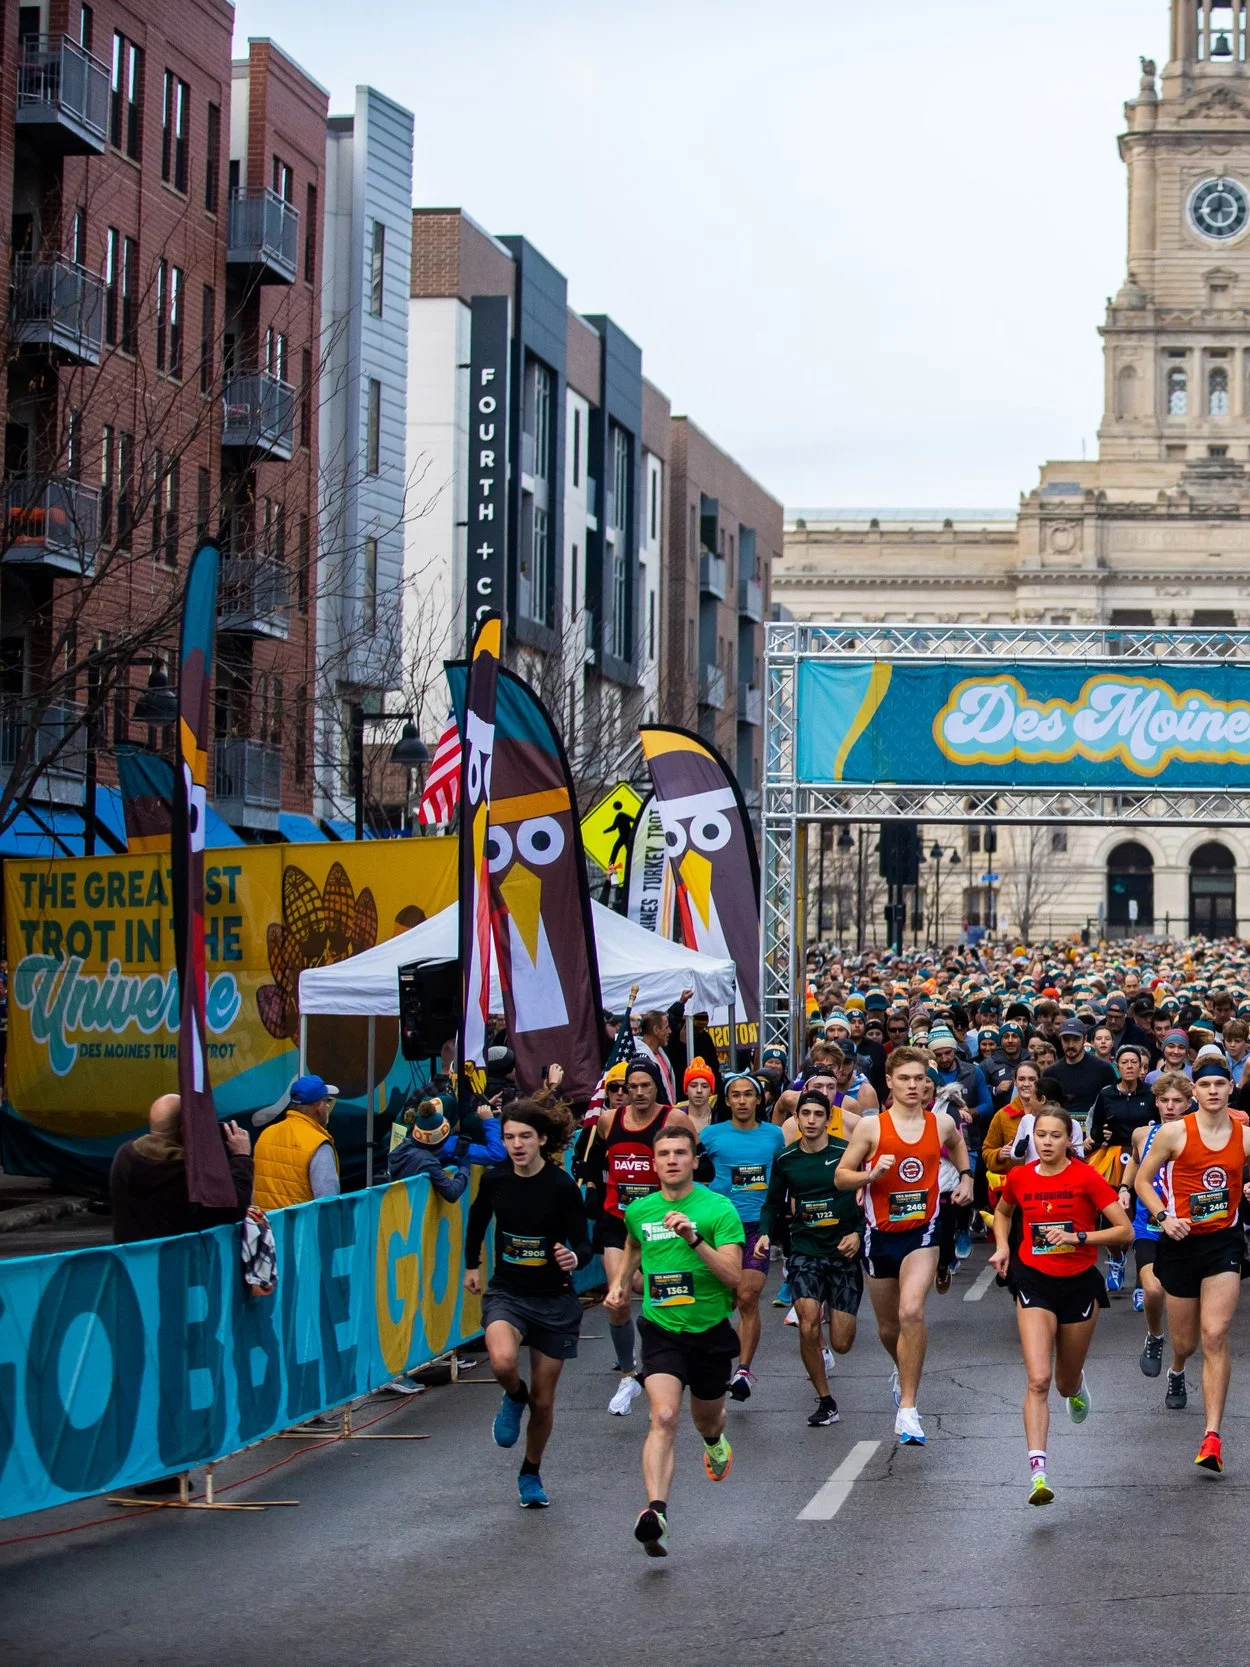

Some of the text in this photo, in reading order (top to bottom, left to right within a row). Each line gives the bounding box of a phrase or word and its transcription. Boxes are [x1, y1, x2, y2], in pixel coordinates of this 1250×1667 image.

[478, 368, 496, 521] FOURTH
[943, 684, 1066, 744] Des
[642, 846, 665, 892] TURKEY
[19, 865, 242, 909] THE GREAST
[639, 898, 659, 932] INES
[19, 915, 243, 963] TROT IN HE
[13, 952, 242, 1077] Univere
[79, 1043, 101, 1058] DES
[104, 1043, 150, 1060] MOINES
[153, 1044, 176, 1060] TUR
[614, 1160, 650, 1171] DAVE'S
[816, 1210, 834, 1219] 1722
[906, 1203, 927, 1212] 2469
[1209, 1202, 1228, 1212] 2467
[521, 1249, 546, 1257] 2908
[666, 1286, 689, 1295] 1362
[0, 1198, 359, 1493] OBBLE
